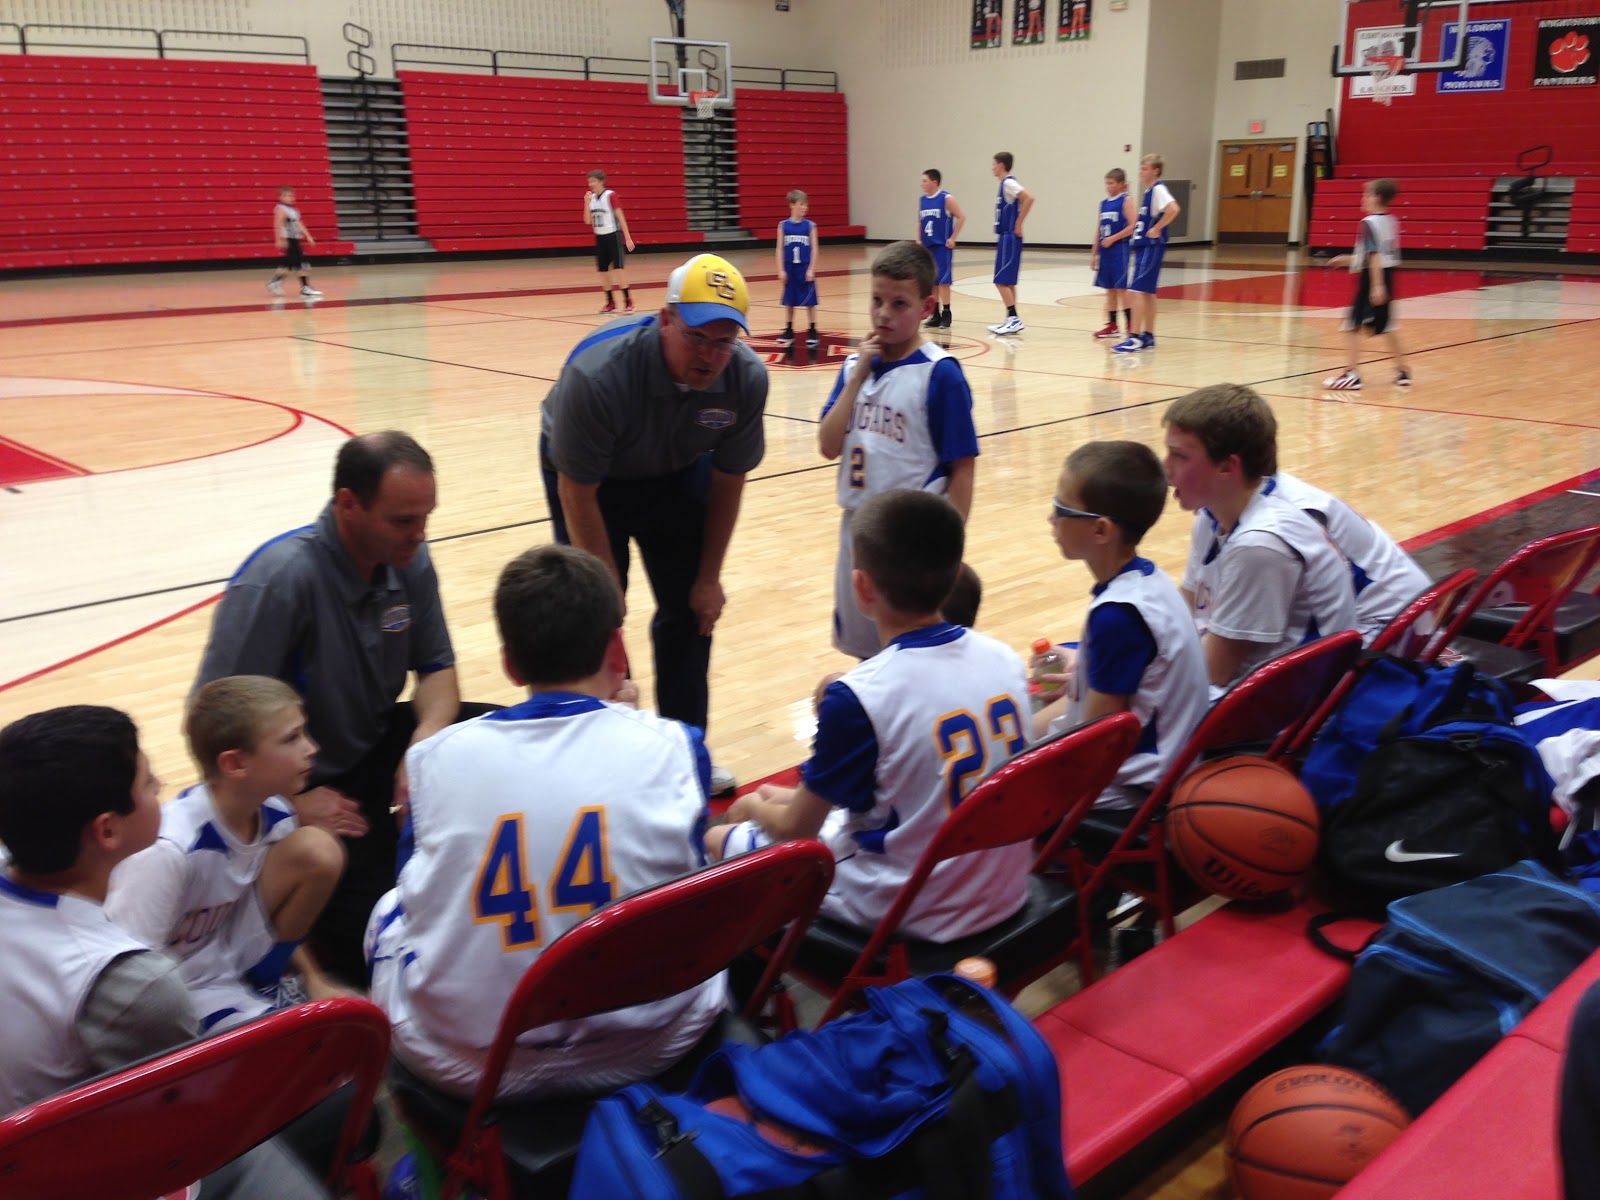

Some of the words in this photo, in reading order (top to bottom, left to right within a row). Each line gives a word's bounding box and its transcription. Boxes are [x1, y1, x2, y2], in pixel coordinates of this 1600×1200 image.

[924, 220, 934, 237] 4
[792, 246, 801, 264] 1
[850, 445, 865, 490] 2
[470, 805, 620, 953] 44
